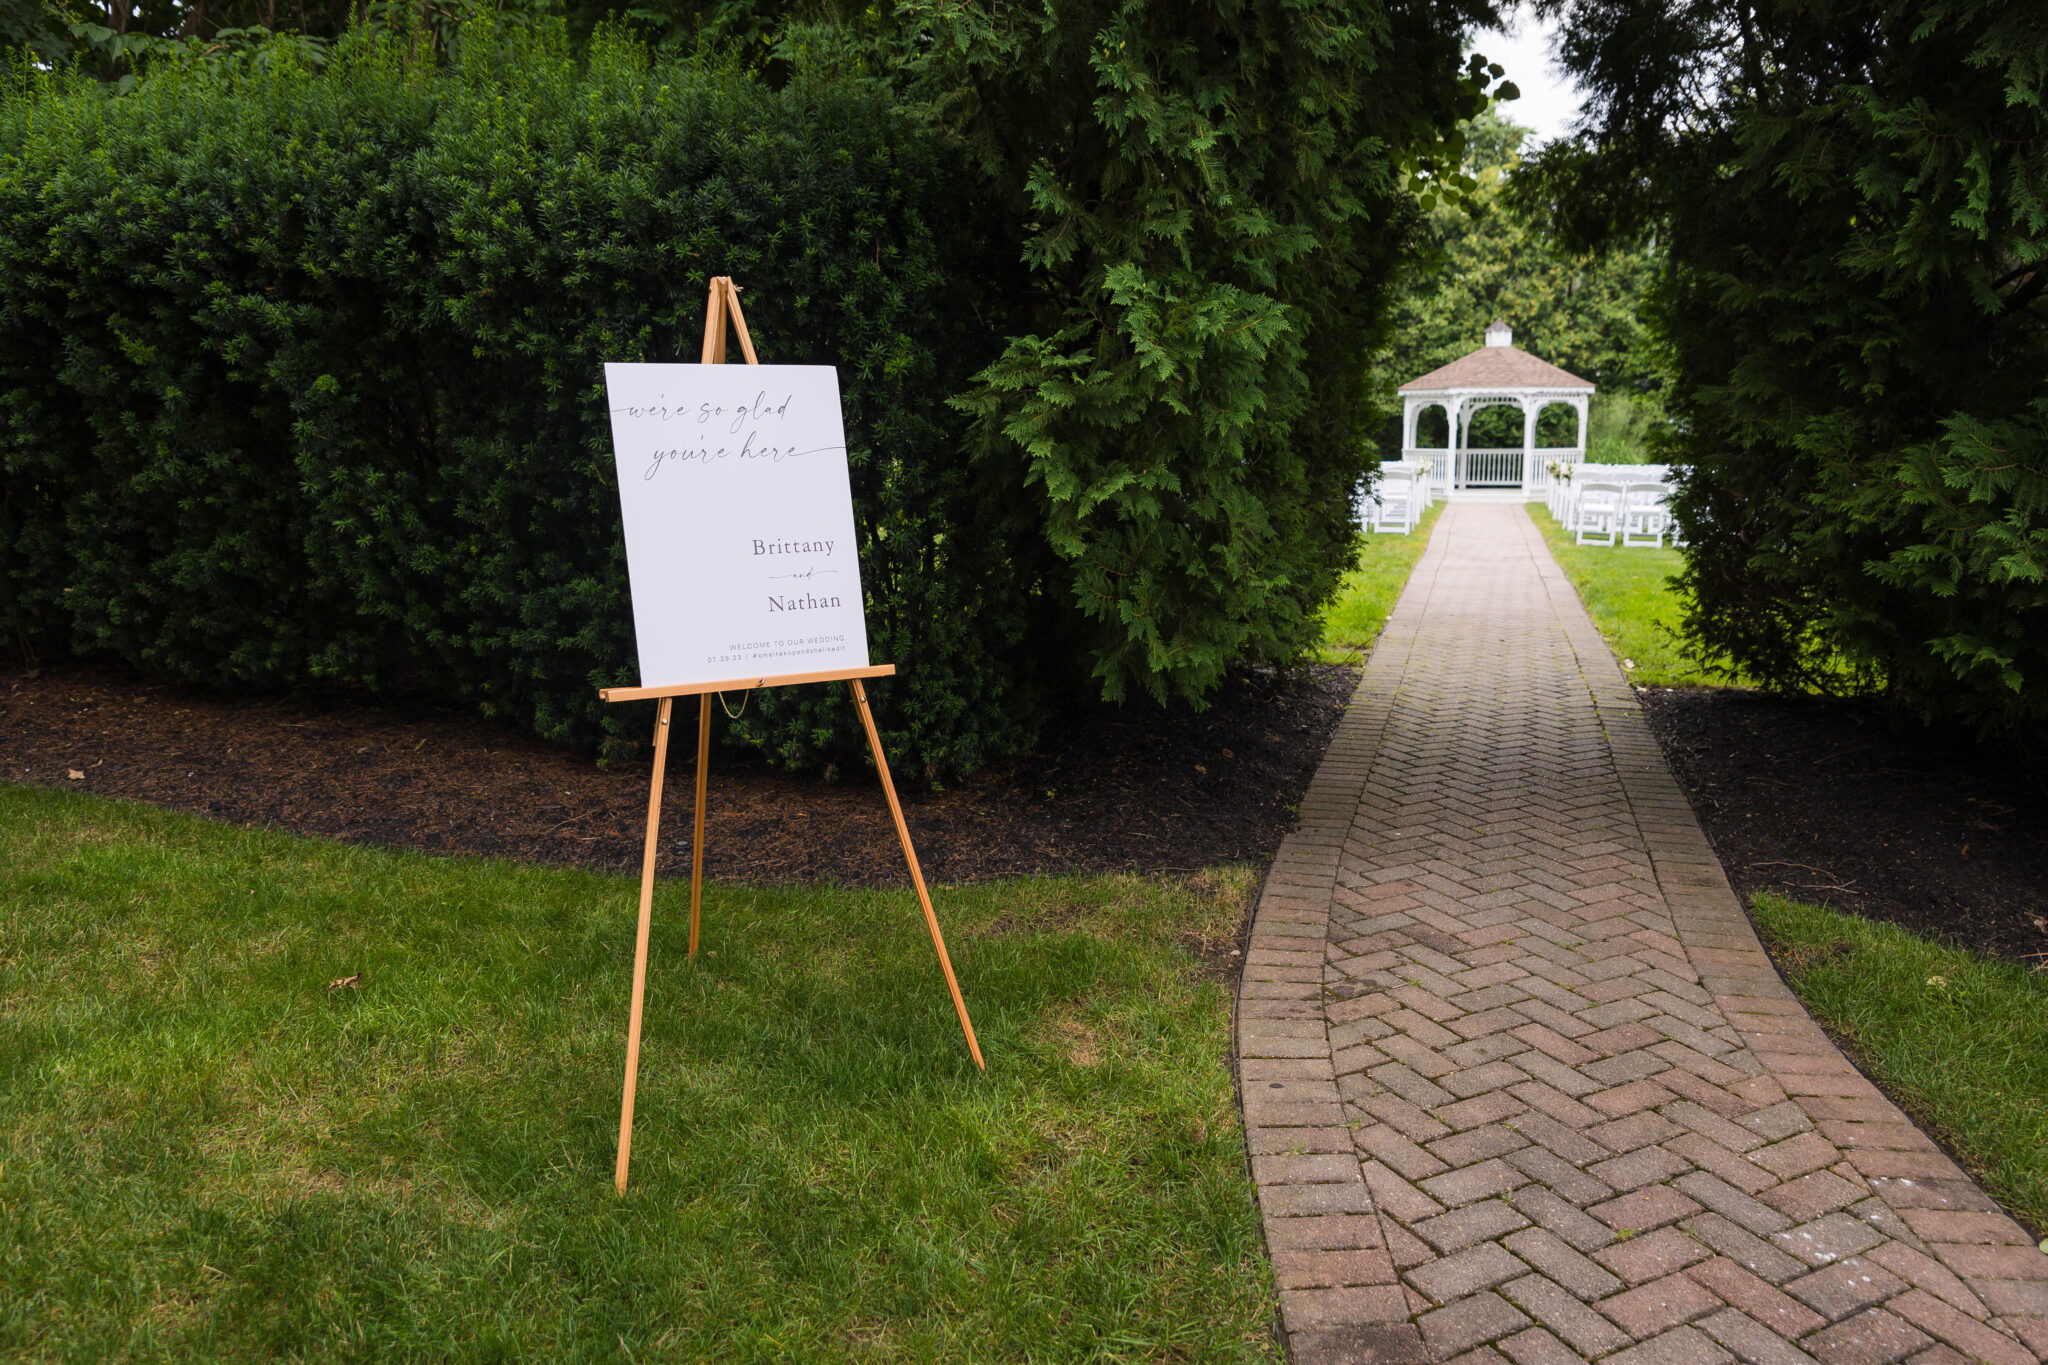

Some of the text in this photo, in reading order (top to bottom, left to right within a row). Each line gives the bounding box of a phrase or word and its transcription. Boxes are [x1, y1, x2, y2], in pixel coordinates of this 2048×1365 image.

[610, 391, 792, 433] we're so glad
[645, 431, 846, 480] you're here
[752, 538, 834, 556] Brittany
[768, 592, 841, 612] Nathan
[729, 641, 770, 651] WELCOME
[787, 638, 804, 646] OUR
[806, 635, 845, 644] WEDDING
